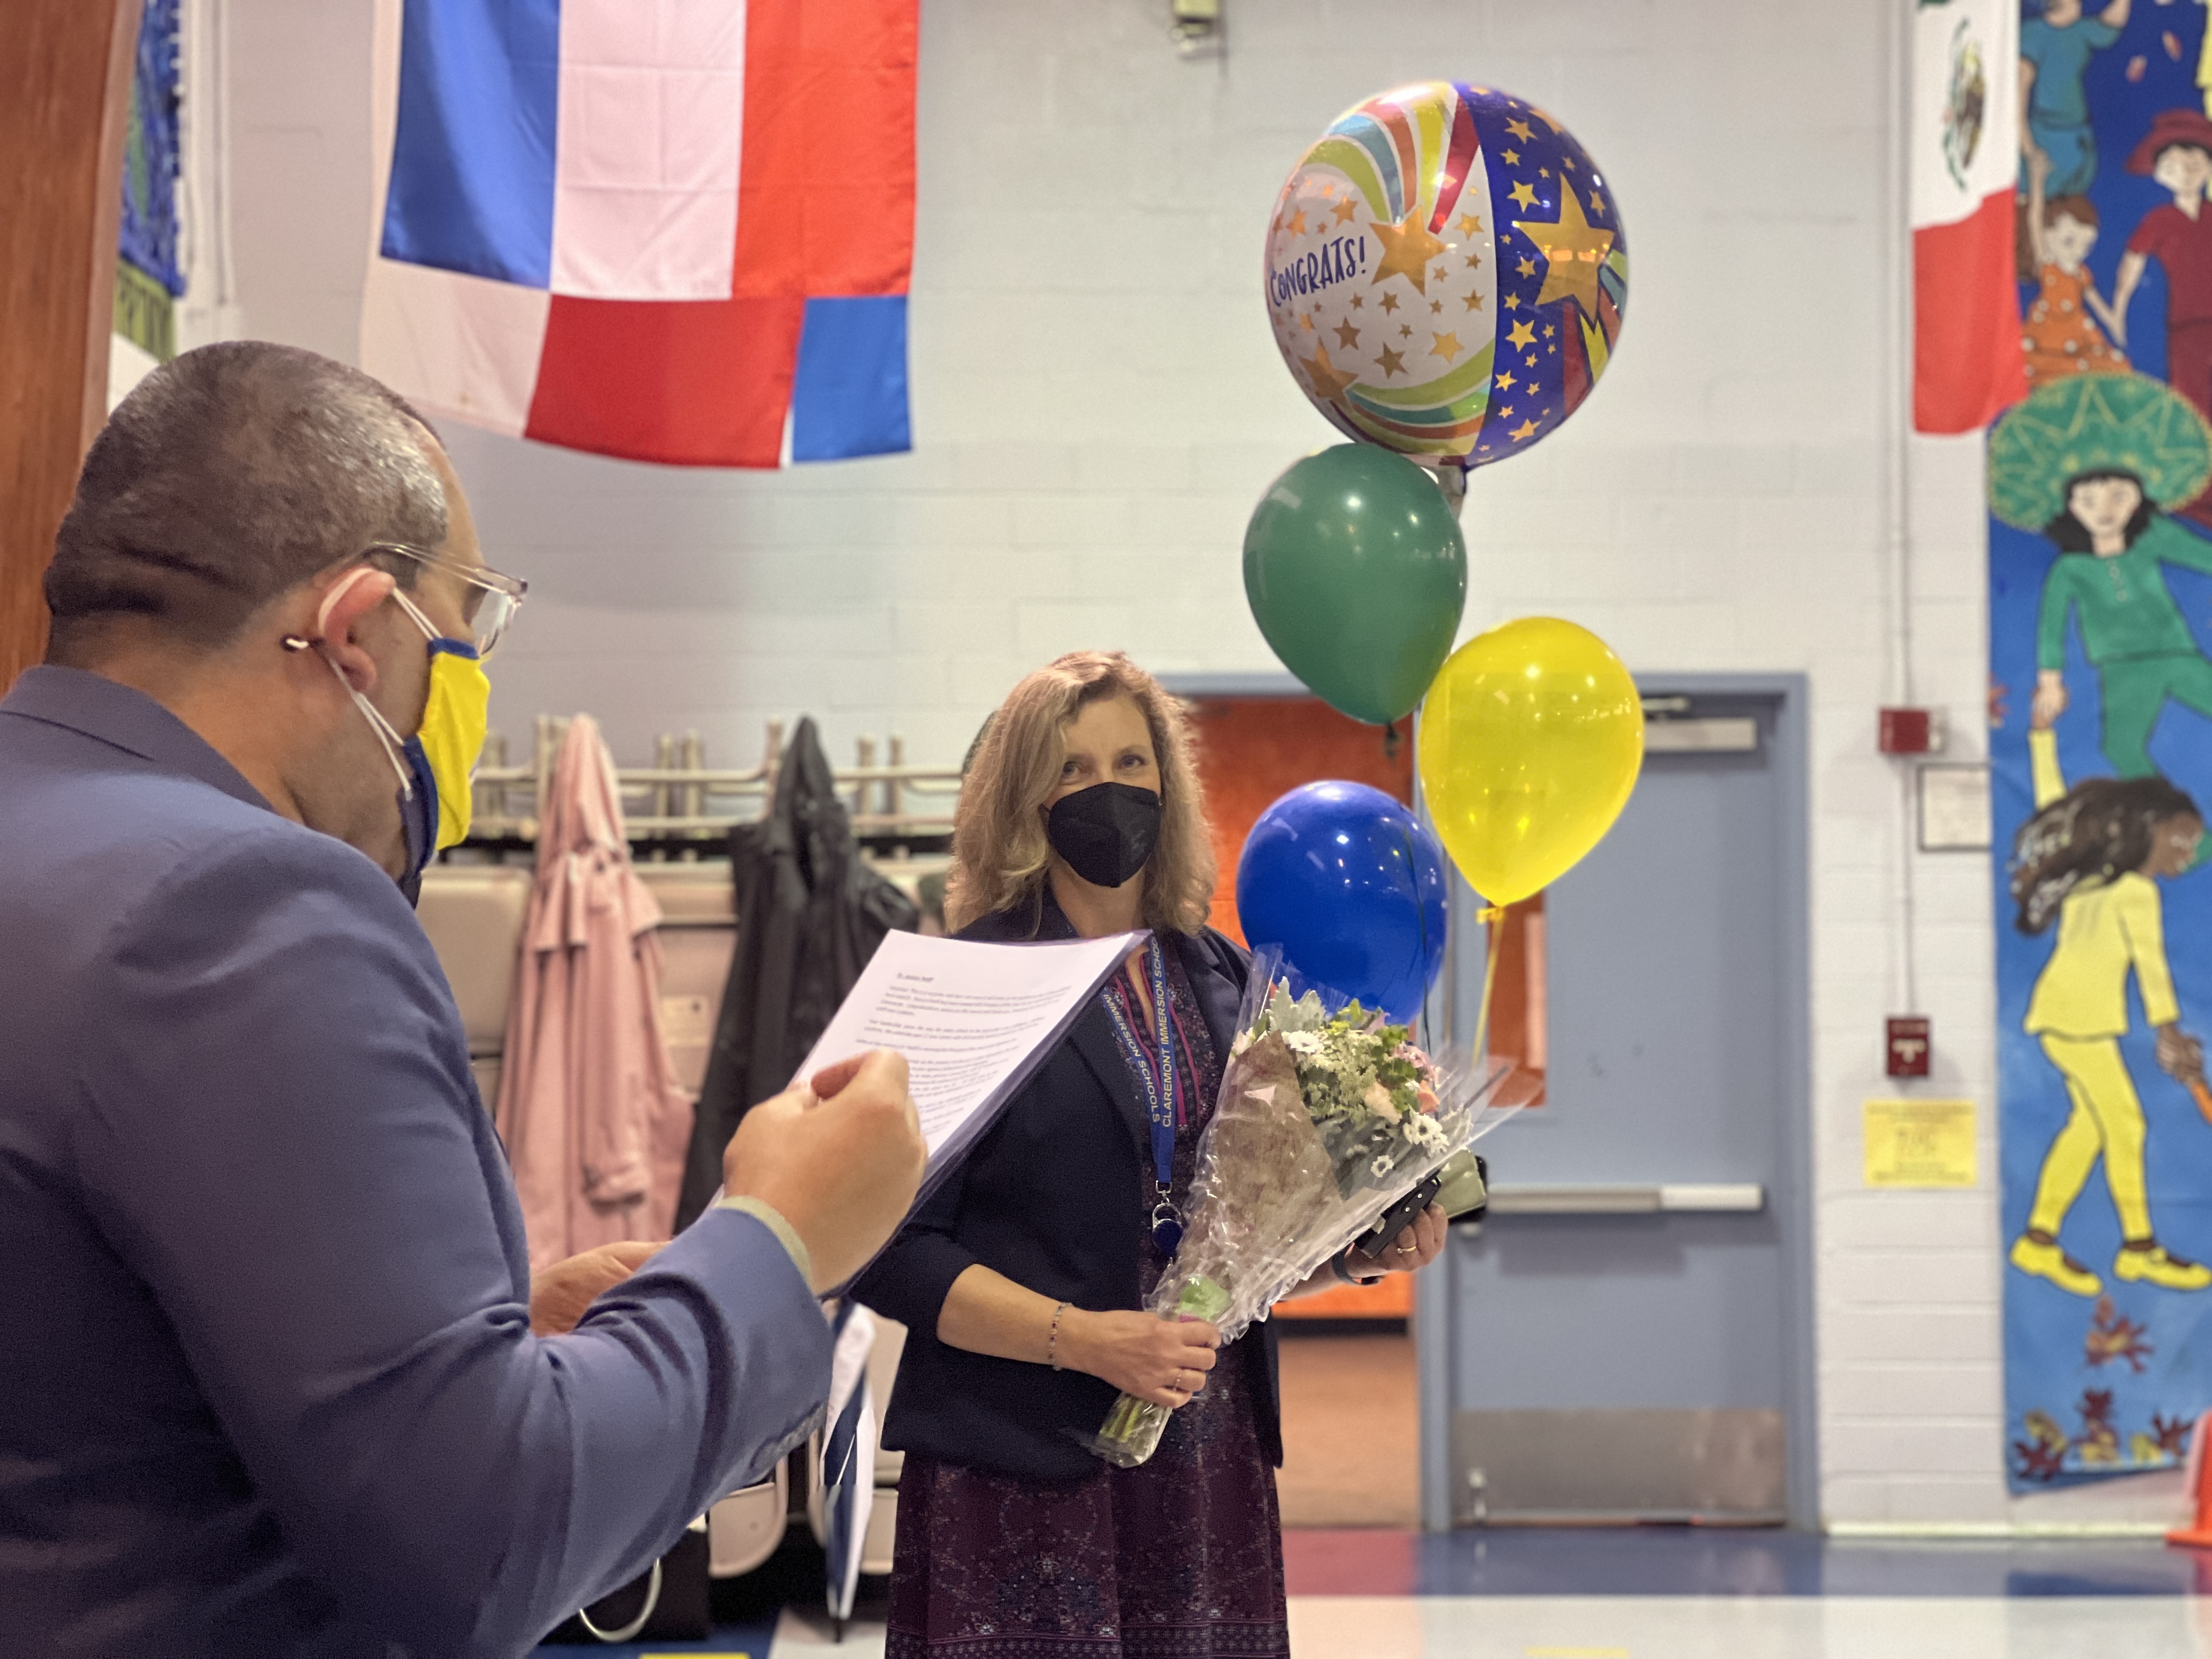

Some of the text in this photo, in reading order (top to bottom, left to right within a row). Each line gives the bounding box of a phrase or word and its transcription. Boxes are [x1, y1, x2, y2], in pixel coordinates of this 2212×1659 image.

[1270, 236, 1366, 307] CONGRATS!
[1103, 994, 1160, 1122] IMMERSION SCHOOLS
[1152, 936, 1172, 1127] CLAREMONT IMMERSION SCHOO
